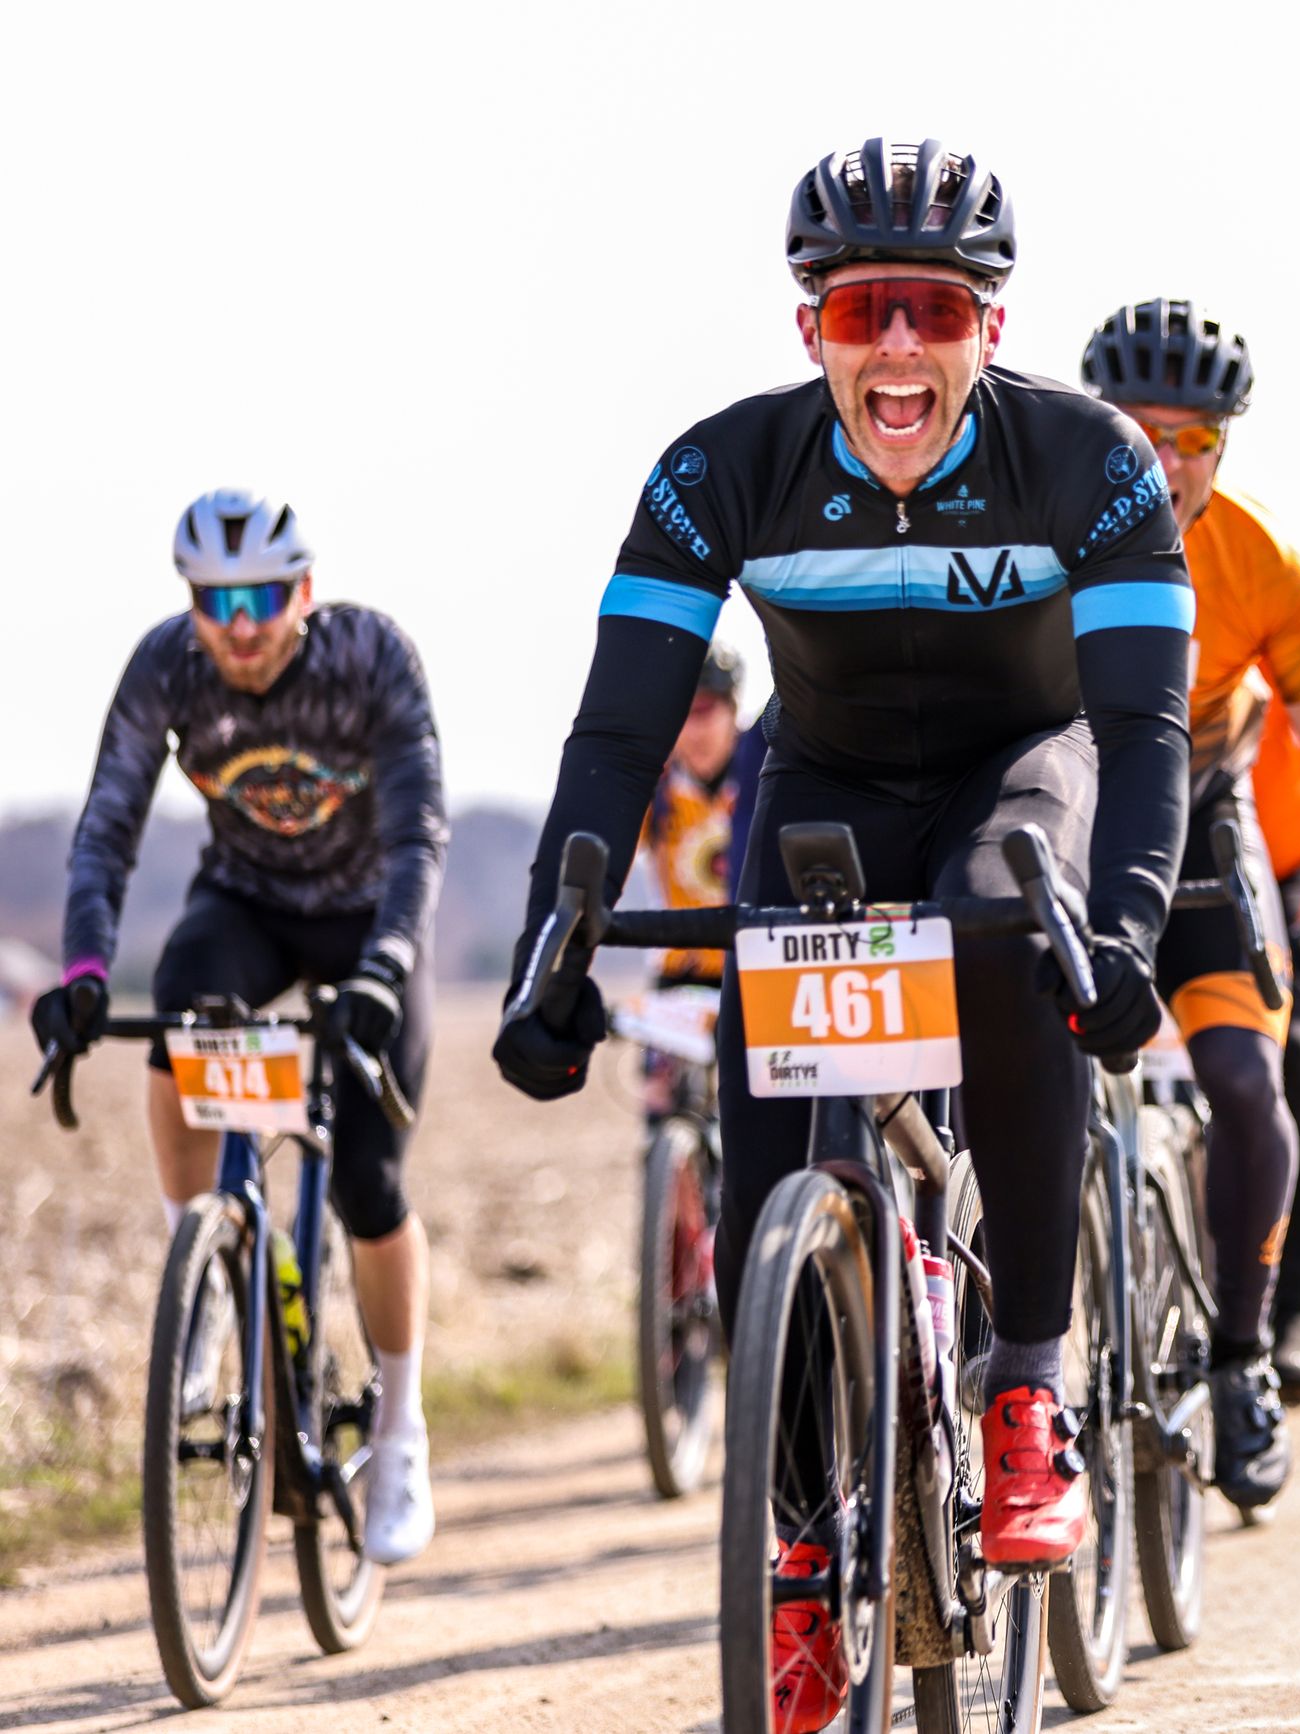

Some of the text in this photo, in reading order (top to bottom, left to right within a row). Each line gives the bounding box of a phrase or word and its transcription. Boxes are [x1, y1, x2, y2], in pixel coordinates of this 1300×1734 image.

[936, 499, 986, 512] WHITE PINE
[784, 932, 860, 963] DIRTY
[791, 967, 905, 1039] 461
